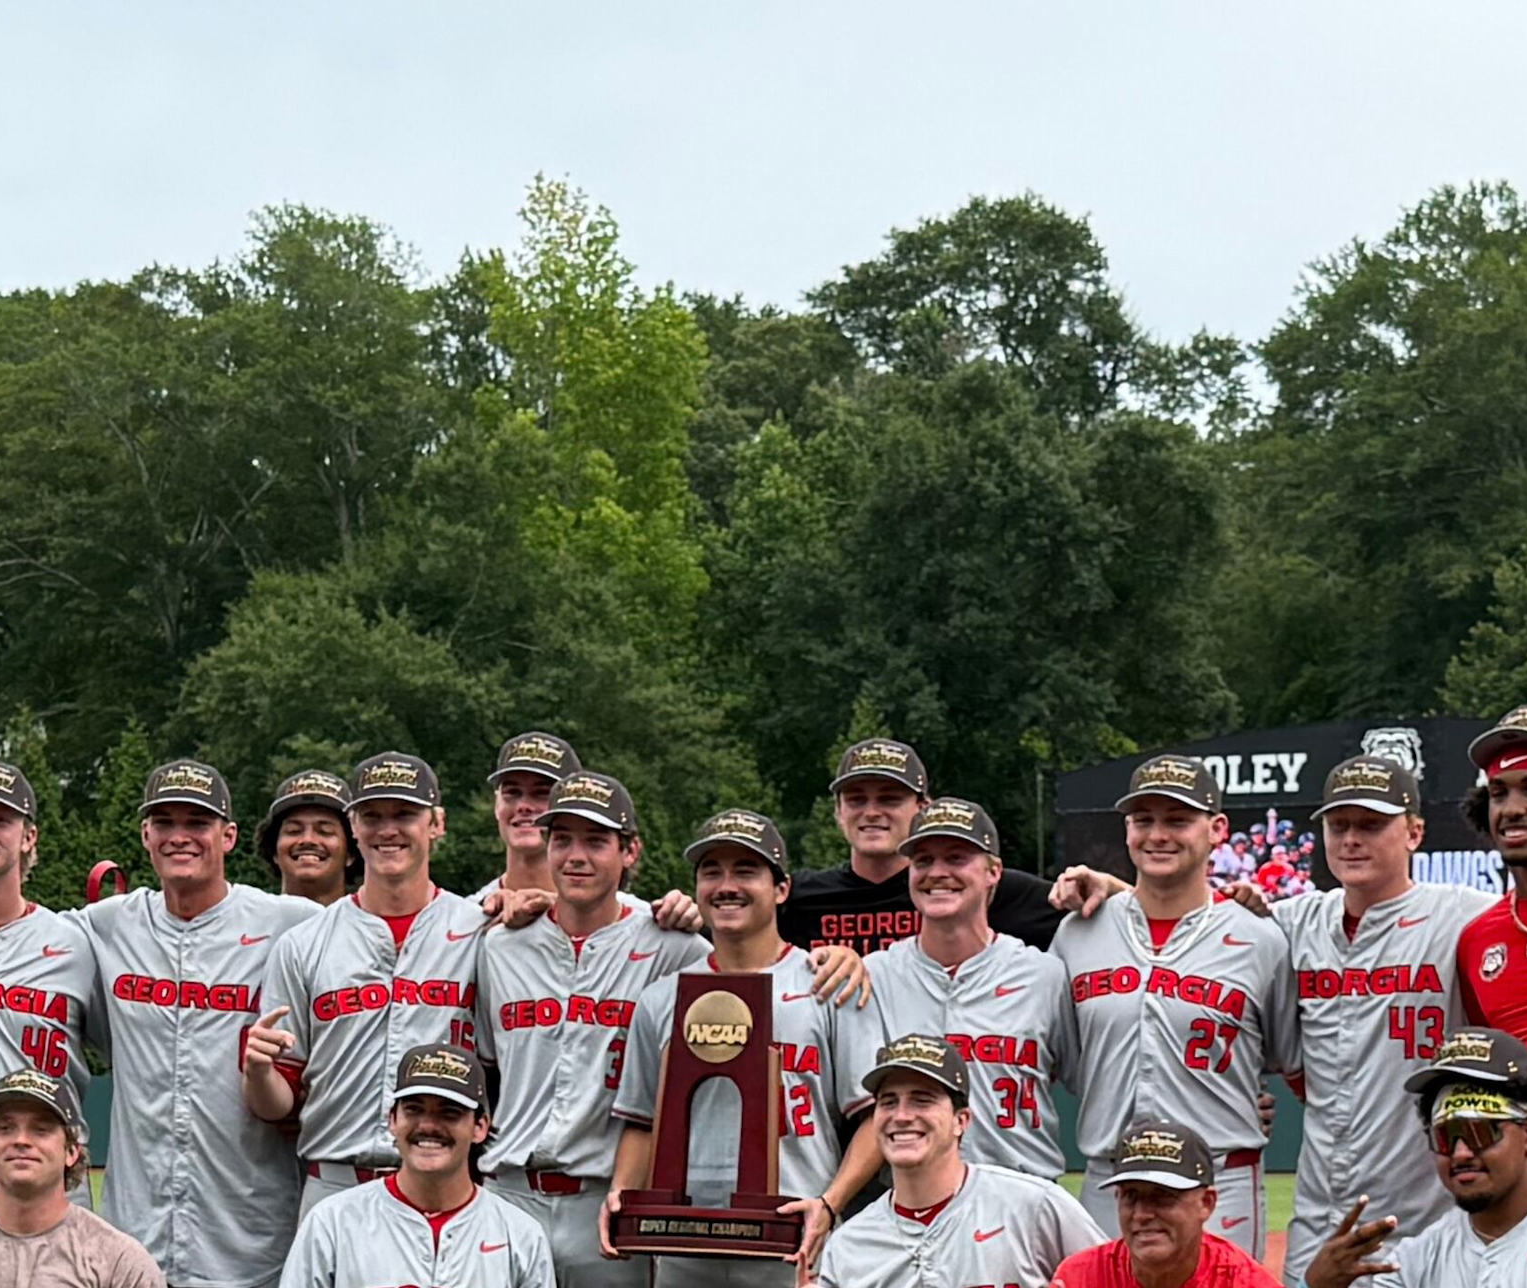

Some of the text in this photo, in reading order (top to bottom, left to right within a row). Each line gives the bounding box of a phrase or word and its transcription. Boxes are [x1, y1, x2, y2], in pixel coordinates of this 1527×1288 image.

[1191, 753, 1308, 795] OLEY
[1412, 851, 1504, 893] DAWGS
[1072, 966, 1246, 1021] GEORGIA
[21, 1026, 68, 1078] 46
[688, 1024, 748, 1044] NCAA
[1184, 1018, 1239, 1073] 27
[1389, 1006, 1444, 1059] 43
[992, 1077, 1040, 1128] 34
[1445, 1098, 1501, 1111] POWER
